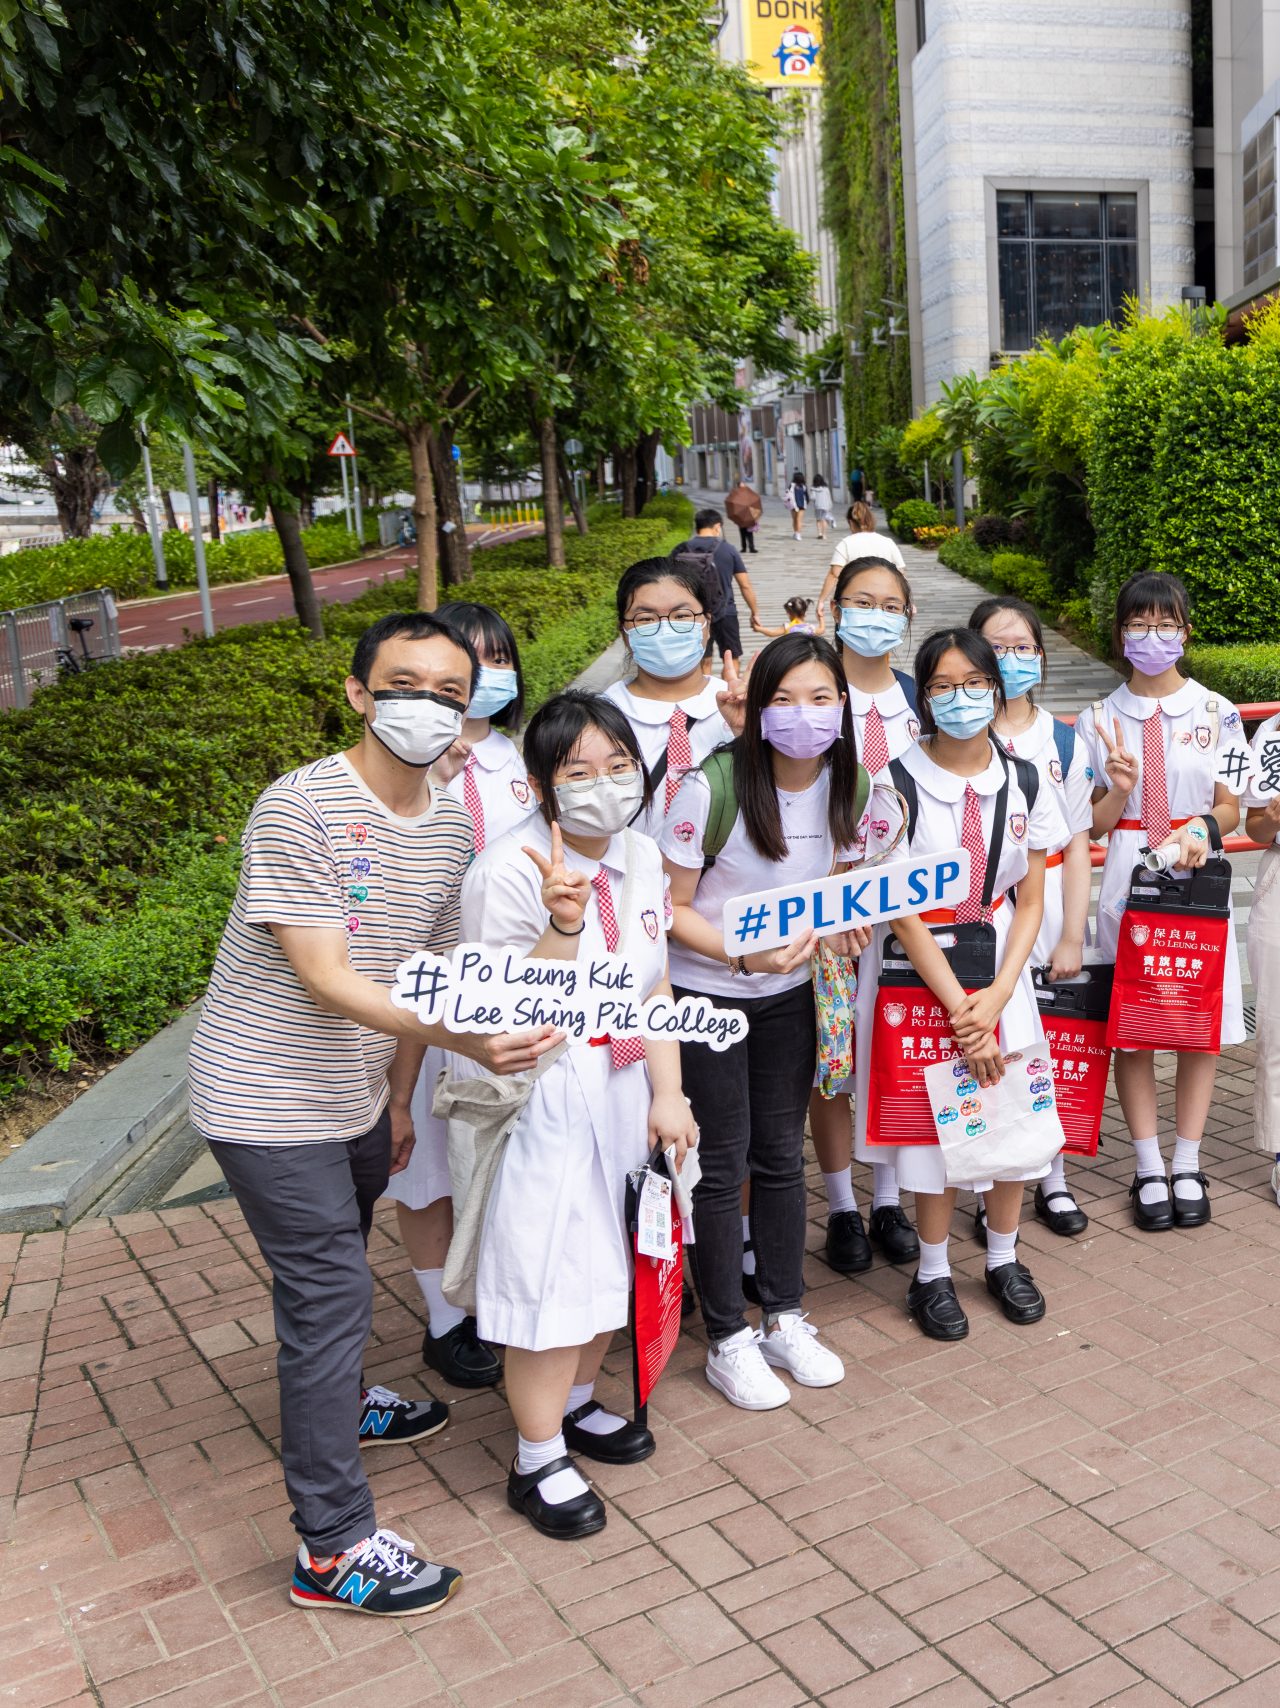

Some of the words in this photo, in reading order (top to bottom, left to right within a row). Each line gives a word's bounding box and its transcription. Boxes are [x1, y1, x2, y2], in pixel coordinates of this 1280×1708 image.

[734, 861, 960, 943] #PLKLSP
[1154, 928, 1196, 941] 保良局
[1152, 939, 1166, 947] PO
[1167, 940, 1198, 949] LEUNG
[1200, 943, 1220, 952] KUK
[460, 952, 492, 983] Po
[504, 955, 577, 997] Leung
[589, 962, 634, 990] Kuk
[1144, 967, 1173, 977] FLAG
[1176, 969, 1199, 979] DAY
[454, 993, 503, 1025] Lee
[513, 998, 585, 1037] Shing
[597, 1001, 638, 1029] Pik
[647, 1004, 741, 1042] College
[912, 1005, 950, 1018] 保良
[911, 1018, 926, 1027] PO
[928, 1019, 953, 1028] LEU
[1045, 1030, 1085, 1044] 保良局
[903, 1050, 937, 1060] FLAG
[1056, 1042, 1086, 1053] LEUNG
[1088, 1046, 1107, 1056] KUK
[1063, 1071, 1085, 1082] DAY
[359, 1410, 394, 1436] N
[336, 1571, 380, 1607] N
